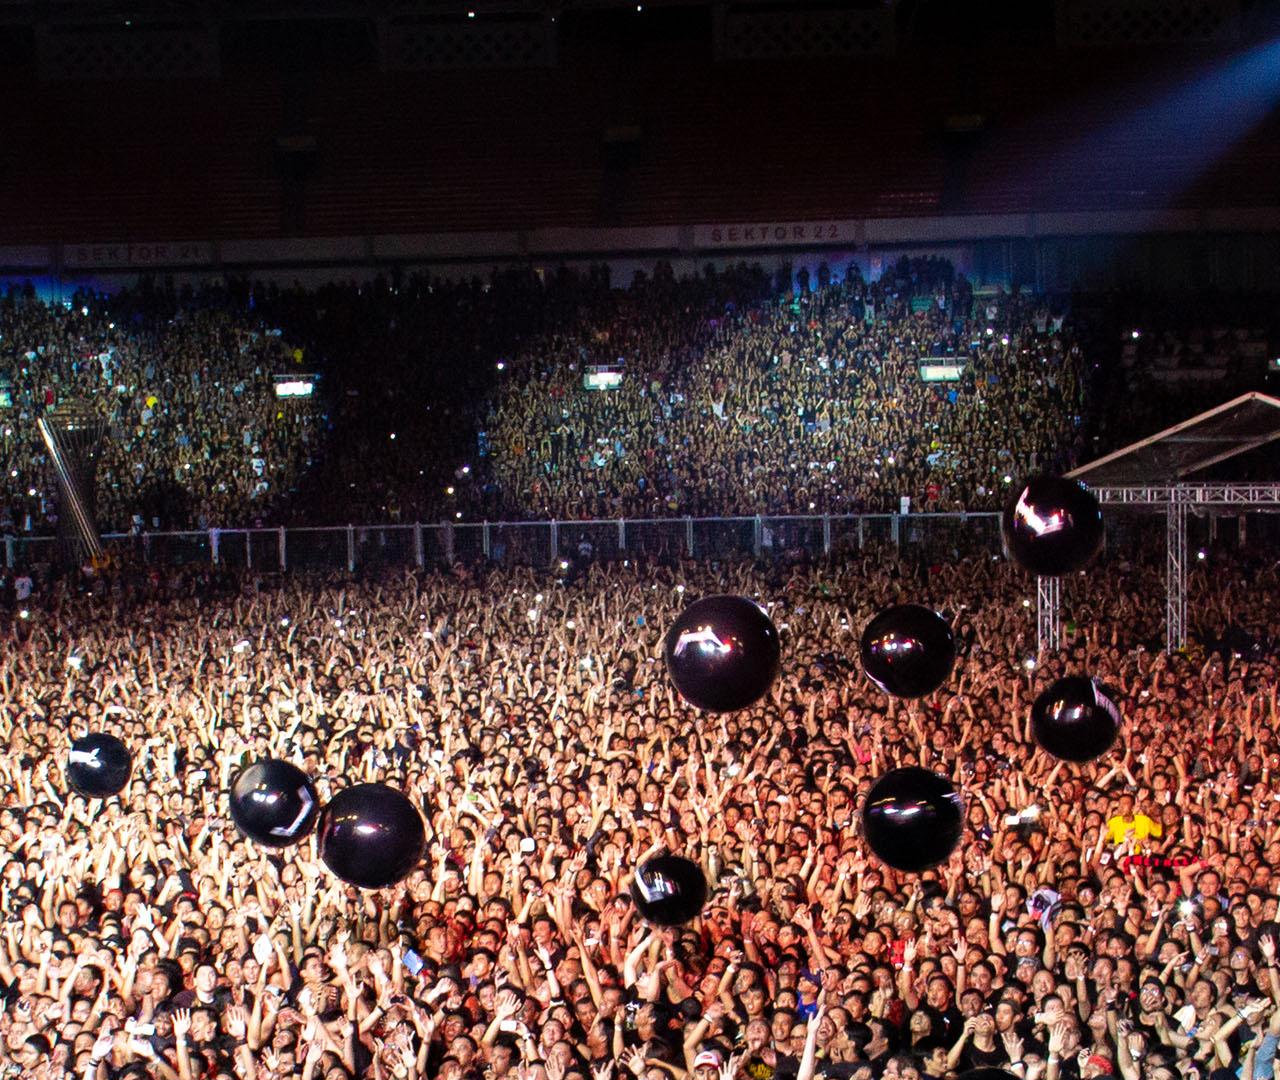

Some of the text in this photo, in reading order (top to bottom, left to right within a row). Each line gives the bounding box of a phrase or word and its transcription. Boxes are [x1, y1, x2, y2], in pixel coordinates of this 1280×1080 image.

[712, 223, 839, 242] SEKTOR 22
[77, 244, 168, 261] SEKTOR
